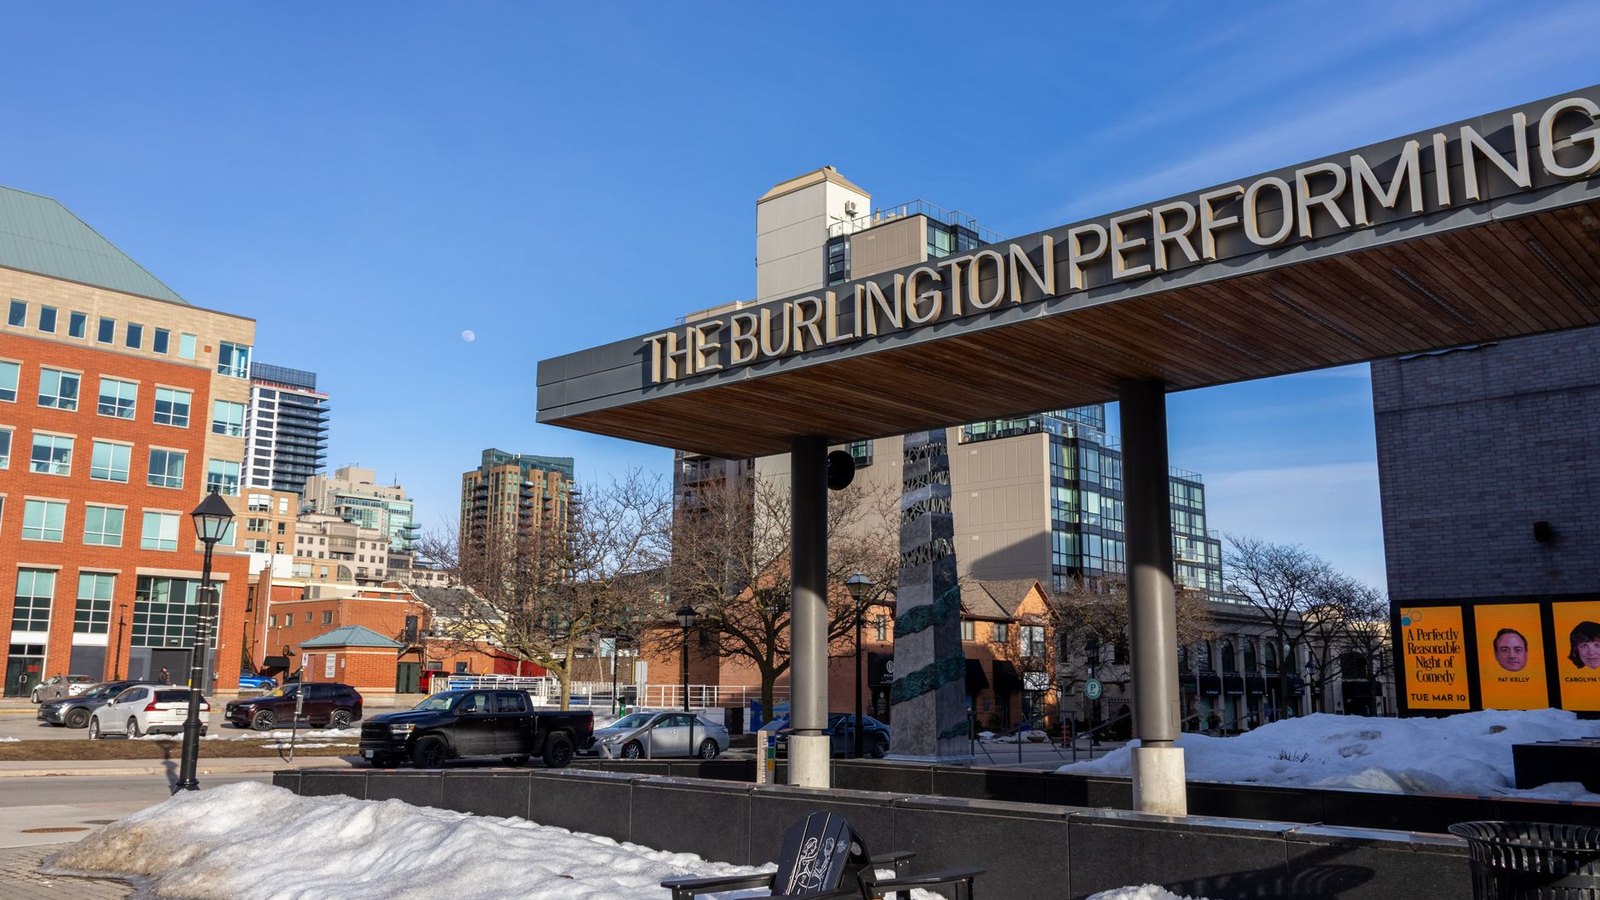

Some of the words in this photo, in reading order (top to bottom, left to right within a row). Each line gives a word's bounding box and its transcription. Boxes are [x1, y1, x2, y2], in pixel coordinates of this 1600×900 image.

[643, 319, 724, 384] THE
[730, 234, 1055, 366] BURLINGTON
[1067, 96, 1600, 291] PERFORMING
[1407, 628, 1414, 641] A
[1416, 627, 1459, 643] Perfectly
[1407, 641, 1461, 655] Reasonable
[1415, 655, 1441, 671] Night
[1443, 655, 1455, 669] of
[1416, 669, 1456, 686] Comedy
[1090, 683, 1096, 691] P
[1410, 693, 1429, 701] TUE
[1432, 694, 1454, 702] MAR
[1456, 694, 1466, 702] 10
